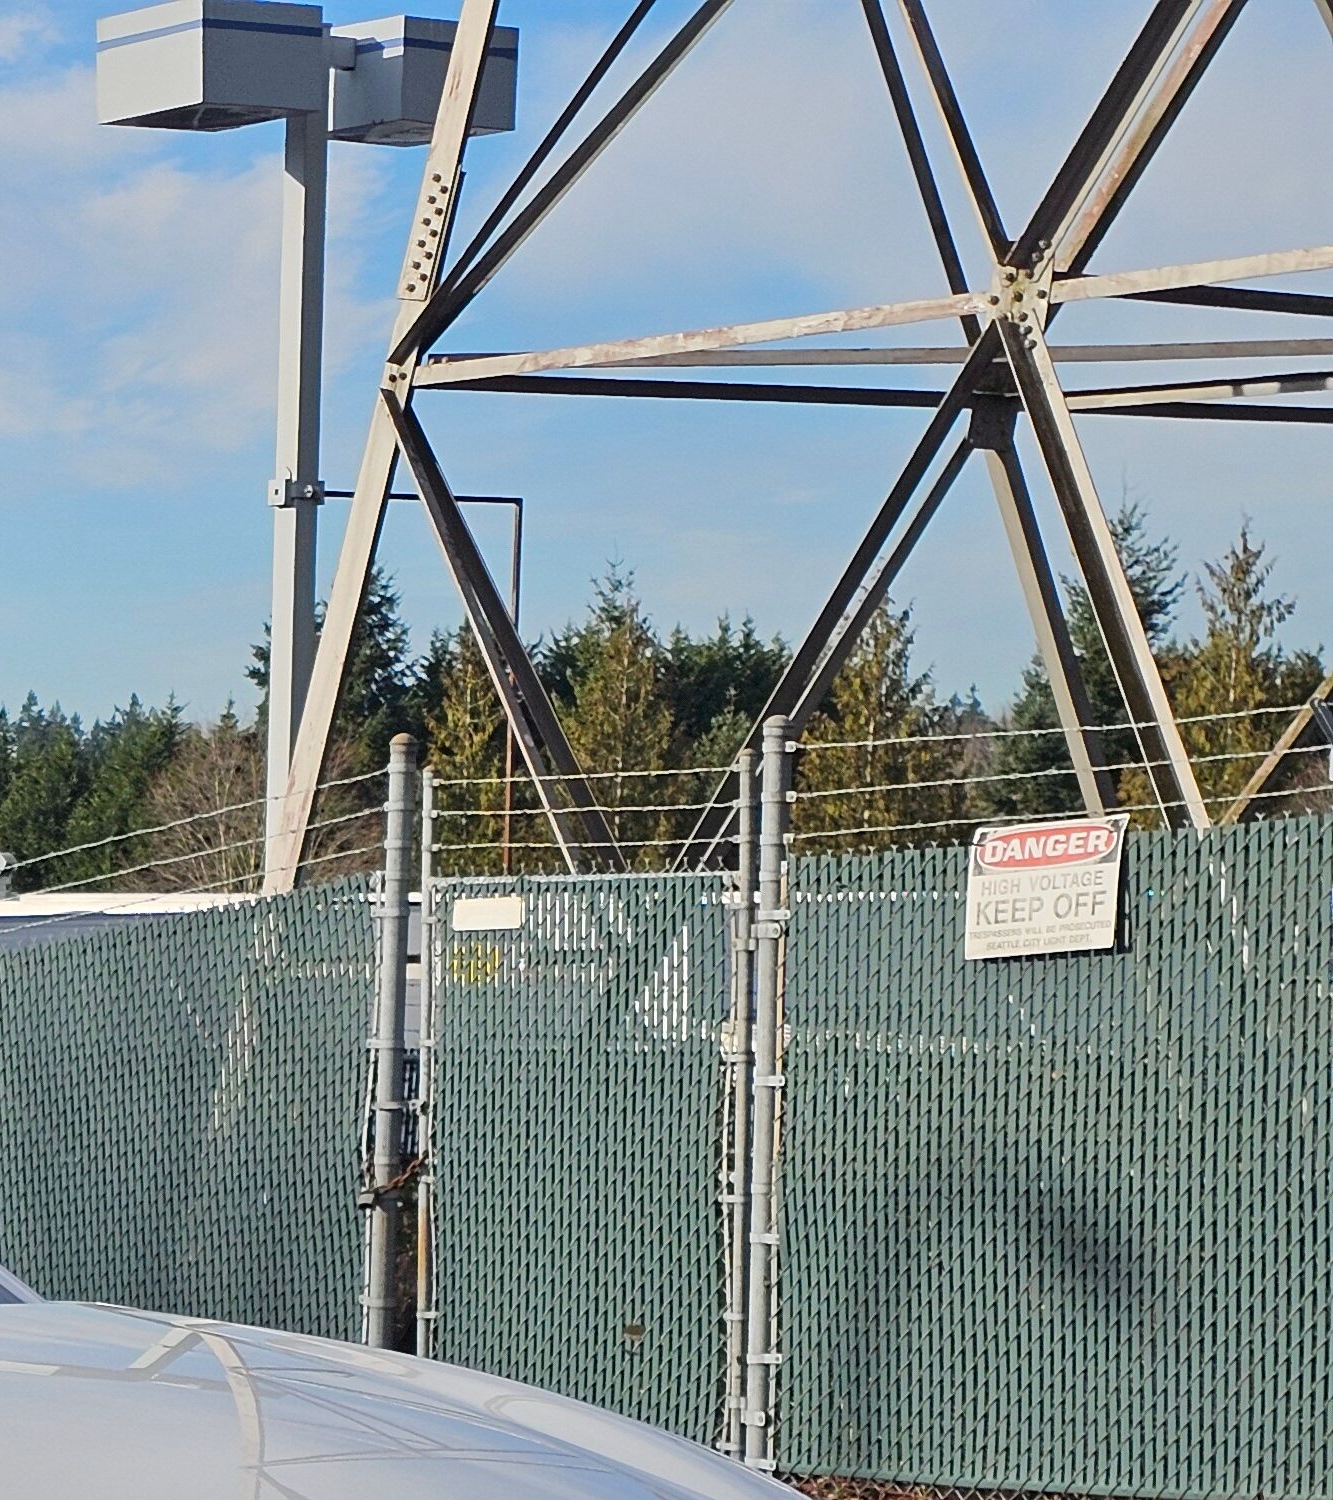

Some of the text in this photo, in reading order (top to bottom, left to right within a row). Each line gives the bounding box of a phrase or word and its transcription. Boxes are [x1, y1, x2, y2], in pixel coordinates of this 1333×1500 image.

[984, 830, 1109, 863] DANGER
[981, 870, 1104, 896] HIGH VOLTAGE
[976, 890, 1107, 926] KEEP OFF
[986, 940, 1022, 950] SEATTLE
[1023, 938, 1041, 947] CITY
